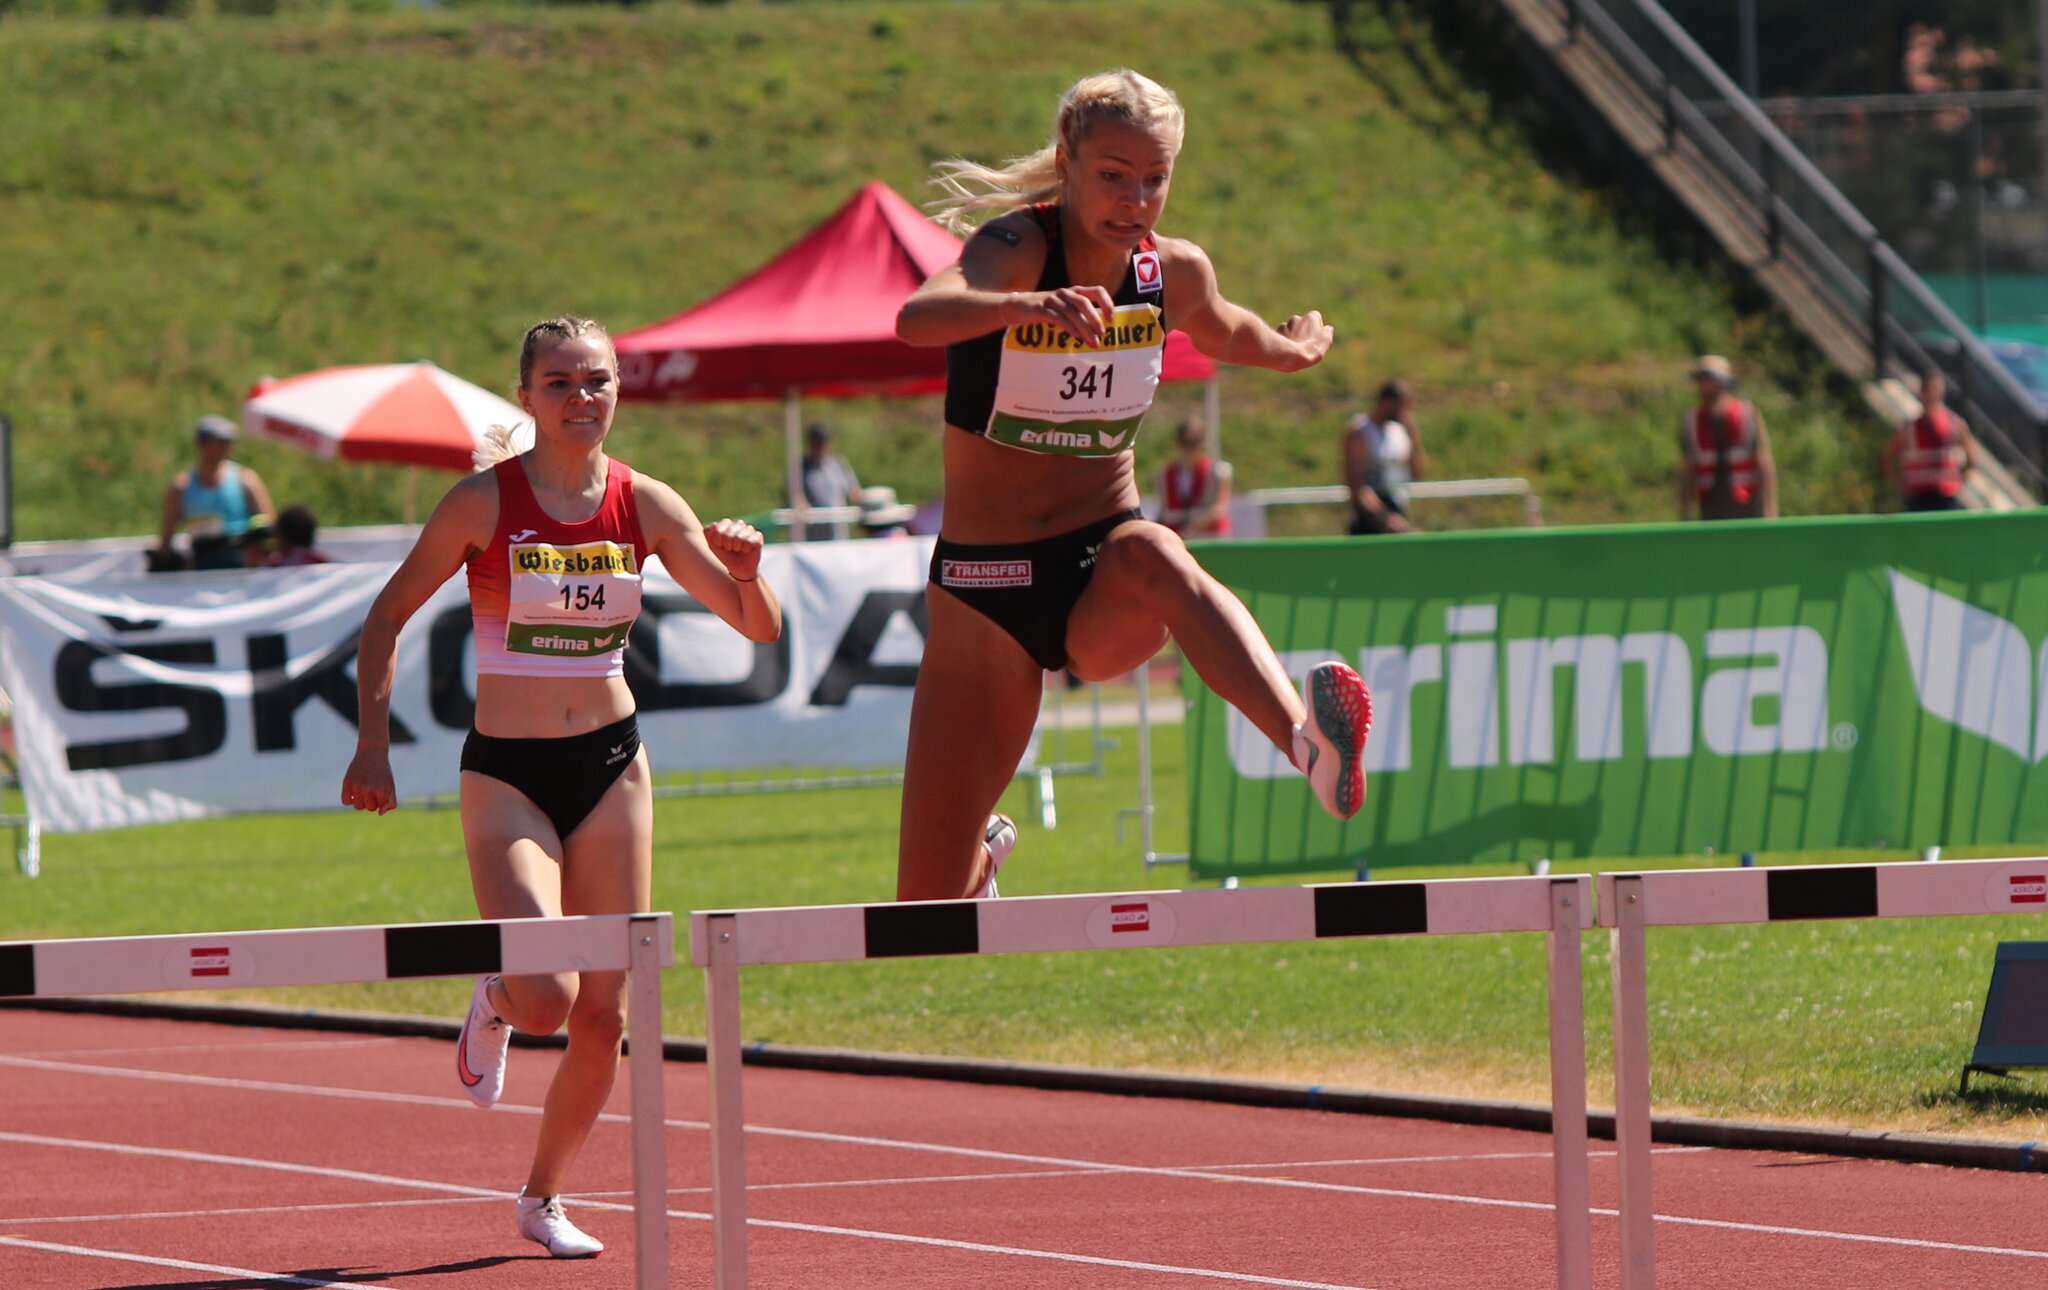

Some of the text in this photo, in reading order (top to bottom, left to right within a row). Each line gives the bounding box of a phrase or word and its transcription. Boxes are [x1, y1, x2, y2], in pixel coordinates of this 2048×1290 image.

[1016, 319, 1157, 348] Wiesauer
[1059, 364, 1114, 400] 341
[1020, 428, 1092, 448] erima
[954, 565, 1027, 577] TRANSFER
[1079, 554, 1098, 569] eri
[560, 584, 605, 610] 154
[531, 635, 589, 651] erima
[55, 588, 932, 772] ŠKDA
